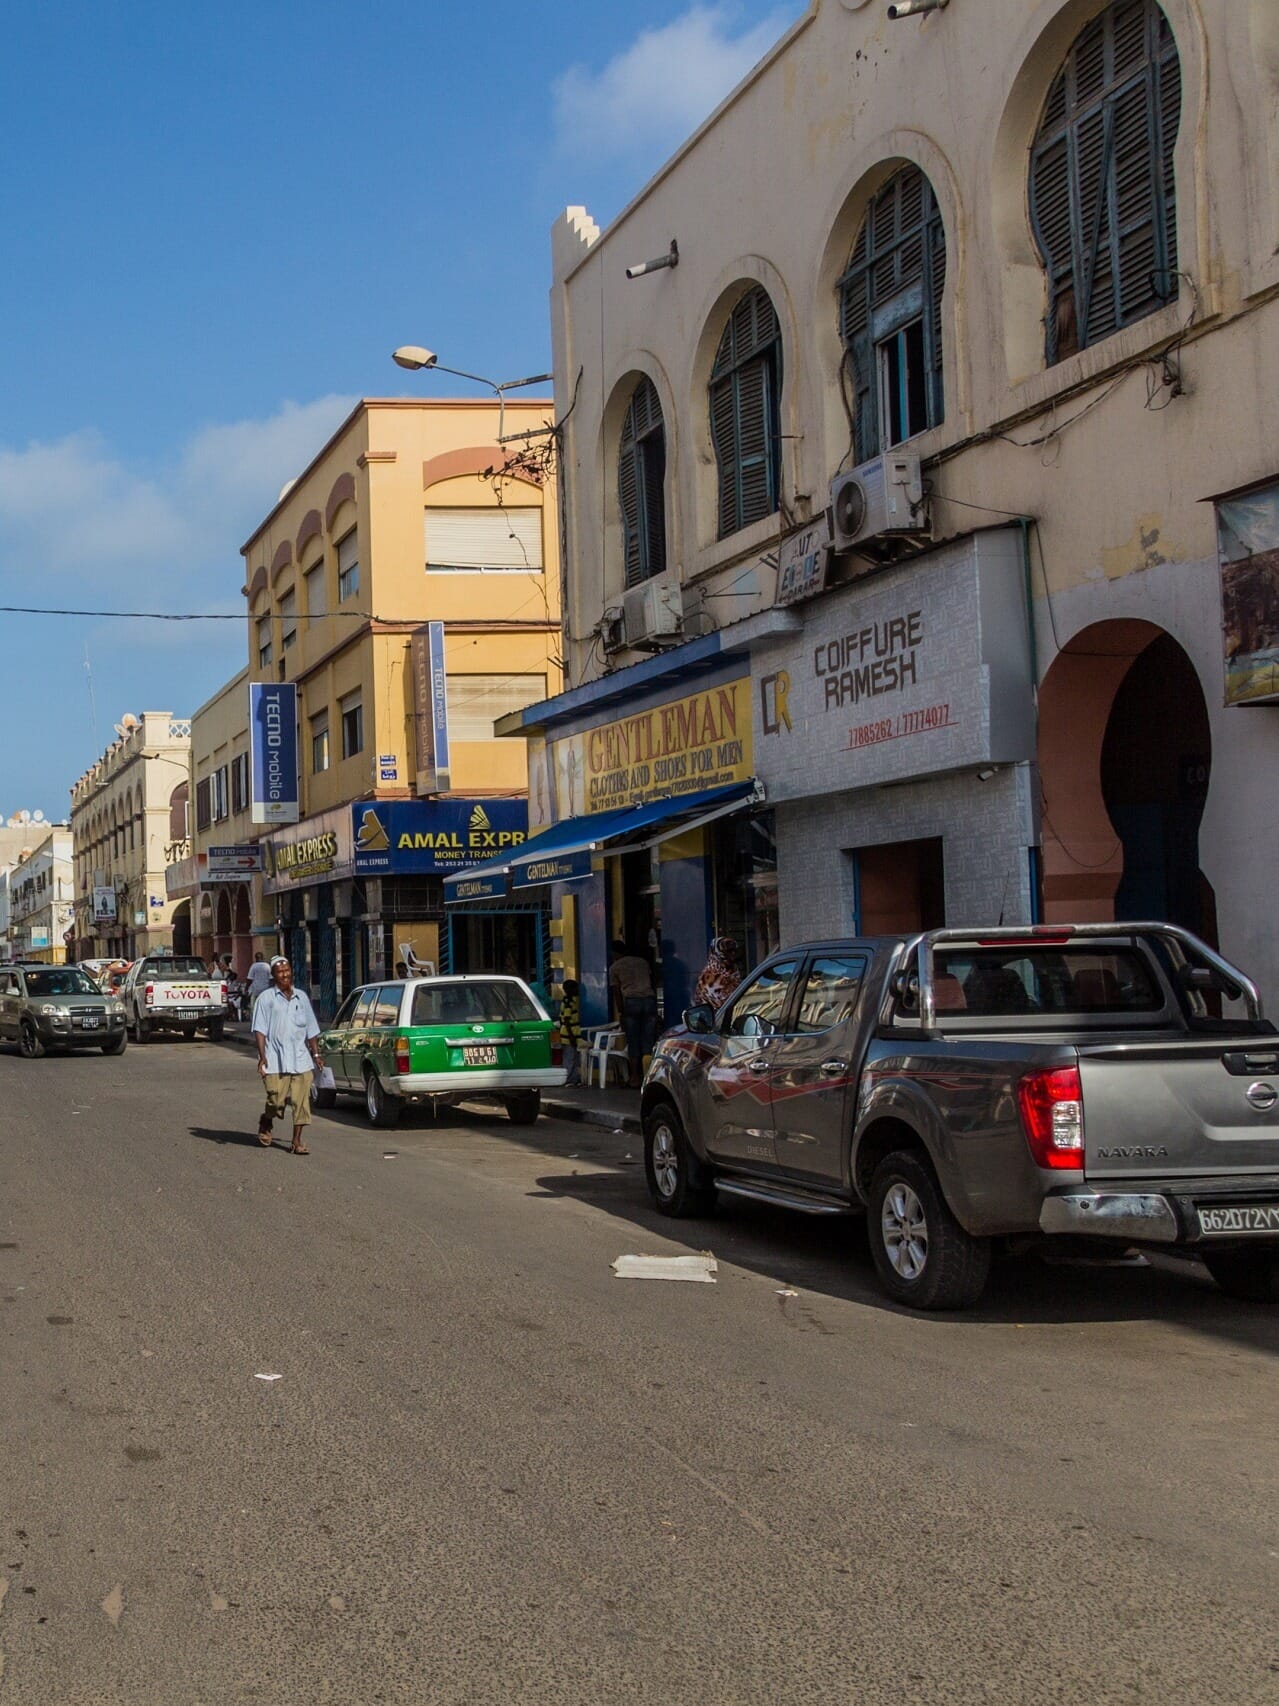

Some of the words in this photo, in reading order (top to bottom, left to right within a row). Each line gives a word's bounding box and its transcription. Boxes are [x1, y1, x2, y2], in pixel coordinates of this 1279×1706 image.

[814, 610, 923, 677] COIFFURE
[434, 667, 443, 699] TECNO
[825, 651, 916, 712] RAMESH
[266, 692, 282, 747] TECNO
[588, 686, 737, 774] GENTLEMAN
[849, 718, 892, 747] 77885262
[902, 704, 949, 733] 77774077
[631, 765, 650, 788] AND
[654, 753, 687, 783] SHOES
[691, 748, 713, 775] FOR
[717, 739, 743, 768] MEN
[214, 848, 235, 856] TECNO
[277, 844, 297, 870] AMAL
[297, 832, 336, 864] EXPRESS
[397, 832, 463, 849] AMAL
[369, 858, 389, 866] EXPRESS
[434, 850, 466, 859] MONEY
[527, 860, 559, 881] GENTELMAN
[164, 990, 211, 1000] TOYOTA
[747, 1145, 774, 1157] DIESEL
[1098, 1146, 1168, 1158] NAVARA
